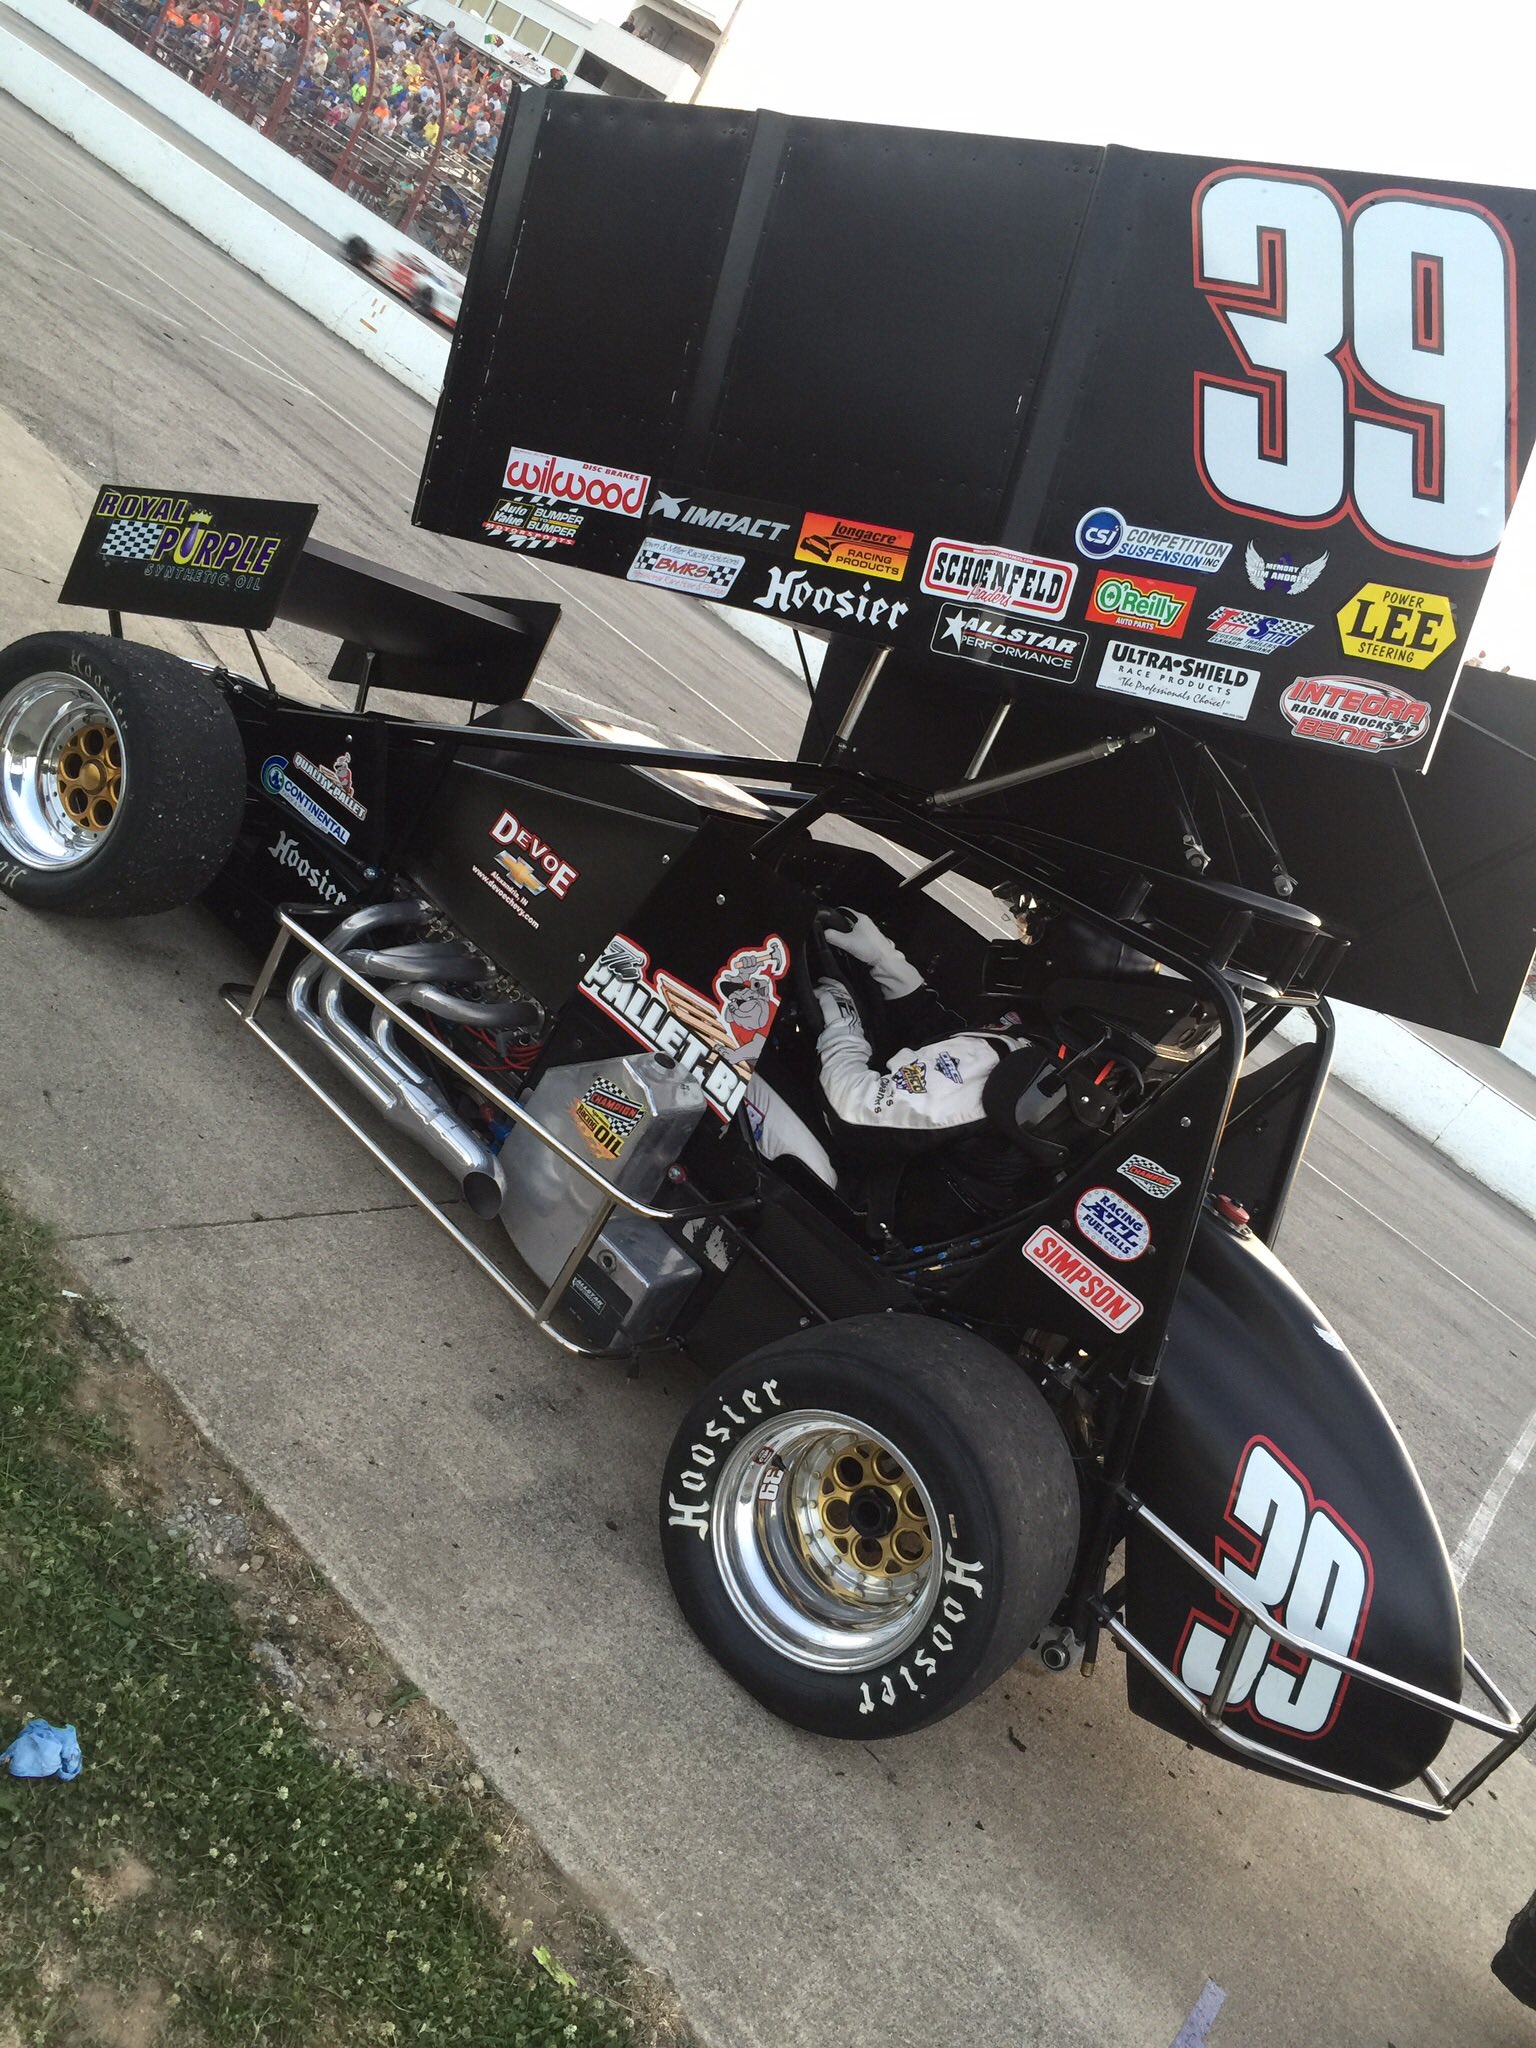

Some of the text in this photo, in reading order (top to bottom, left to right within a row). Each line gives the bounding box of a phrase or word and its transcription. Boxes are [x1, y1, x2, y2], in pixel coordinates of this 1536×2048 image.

[1197, 171, 1511, 563] 39
[507, 457, 648, 514] wilwood
[582, 463, 640, 481] DISC BRAKES
[96, 492, 188, 523] ROYAL
[493, 511, 524, 526] Value
[500, 502, 528, 516] Auto
[534, 507, 584, 525] BUMPER
[485, 523, 573, 545] MOTORSPORTS
[527, 521, 577, 538] BUMPER
[681, 506, 791, 541] IMPACT
[832, 522, 897, 545] Longacre
[151, 526, 281, 575] PURPLE
[687, 548, 710, 562] Racing
[708, 554, 740, 566] Solutions
[848, 549, 892, 564] RACING
[1119, 543, 1220, 568] SUSPENSION INC
[1126, 529, 1229, 557] COMPETITION
[144, 563, 262, 591] SYNTHETIC OIL
[655, 558, 710, 578] BMRS
[836, 556, 899, 575] PRODUCTS
[1253, 570, 1269, 578] JIM
[1266, 563, 1299, 573] MEMORY
[753, 566, 909, 630] Hoosier
[1097, 579, 1184, 623] O'Reilly
[1383, 590, 1425, 609] POWER
[964, 617, 1078, 654] ALLSTAR
[1116, 617, 1155, 631] AUTO PARTS
[1209, 608, 1298, 646] Team Spirit
[1346, 599, 1444, 653] LEE
[962, 635, 1073, 669] PERFORMANCE
[1215, 633, 1278, 649] CUSTOM TRAILERS
[1244, 644, 1272, 653] INDIANA
[1358, 642, 1414, 663] STEERING
[1118, 665, 1231, 696] RACE PRODUCTS
[1135, 680, 1191, 701] Professionals
[1288, 681, 1430, 724] INTEGRA
[1291, 704, 1338, 720] RACING
[1341, 714, 1394, 731] SHOCKS
[1296, 717, 1387, 750] BENIC
[285, 782, 346, 843] CONTINENTAL
[268, 830, 347, 905] Hoosier
[472, 865, 540, 930] www.devoechevy.com
[591, 1093, 638, 1118] CHAMPION
[577, 1104, 598, 1131] Racing
[594, 1125, 622, 1157] OIL
[1129, 1166, 1173, 1186] CHAMPION
[1082, 1202, 1139, 1247] ATL
[1100, 1196, 1143, 1231] RACING
[1082, 1214, 1131, 1254] FUEL CELLS
[1034, 1237, 1131, 1321] SIMPSON
[668, 1379, 781, 1540] Hoosier
[1177, 1440, 1370, 1737] 39
[859, 1542, 984, 1714] Hoosier
